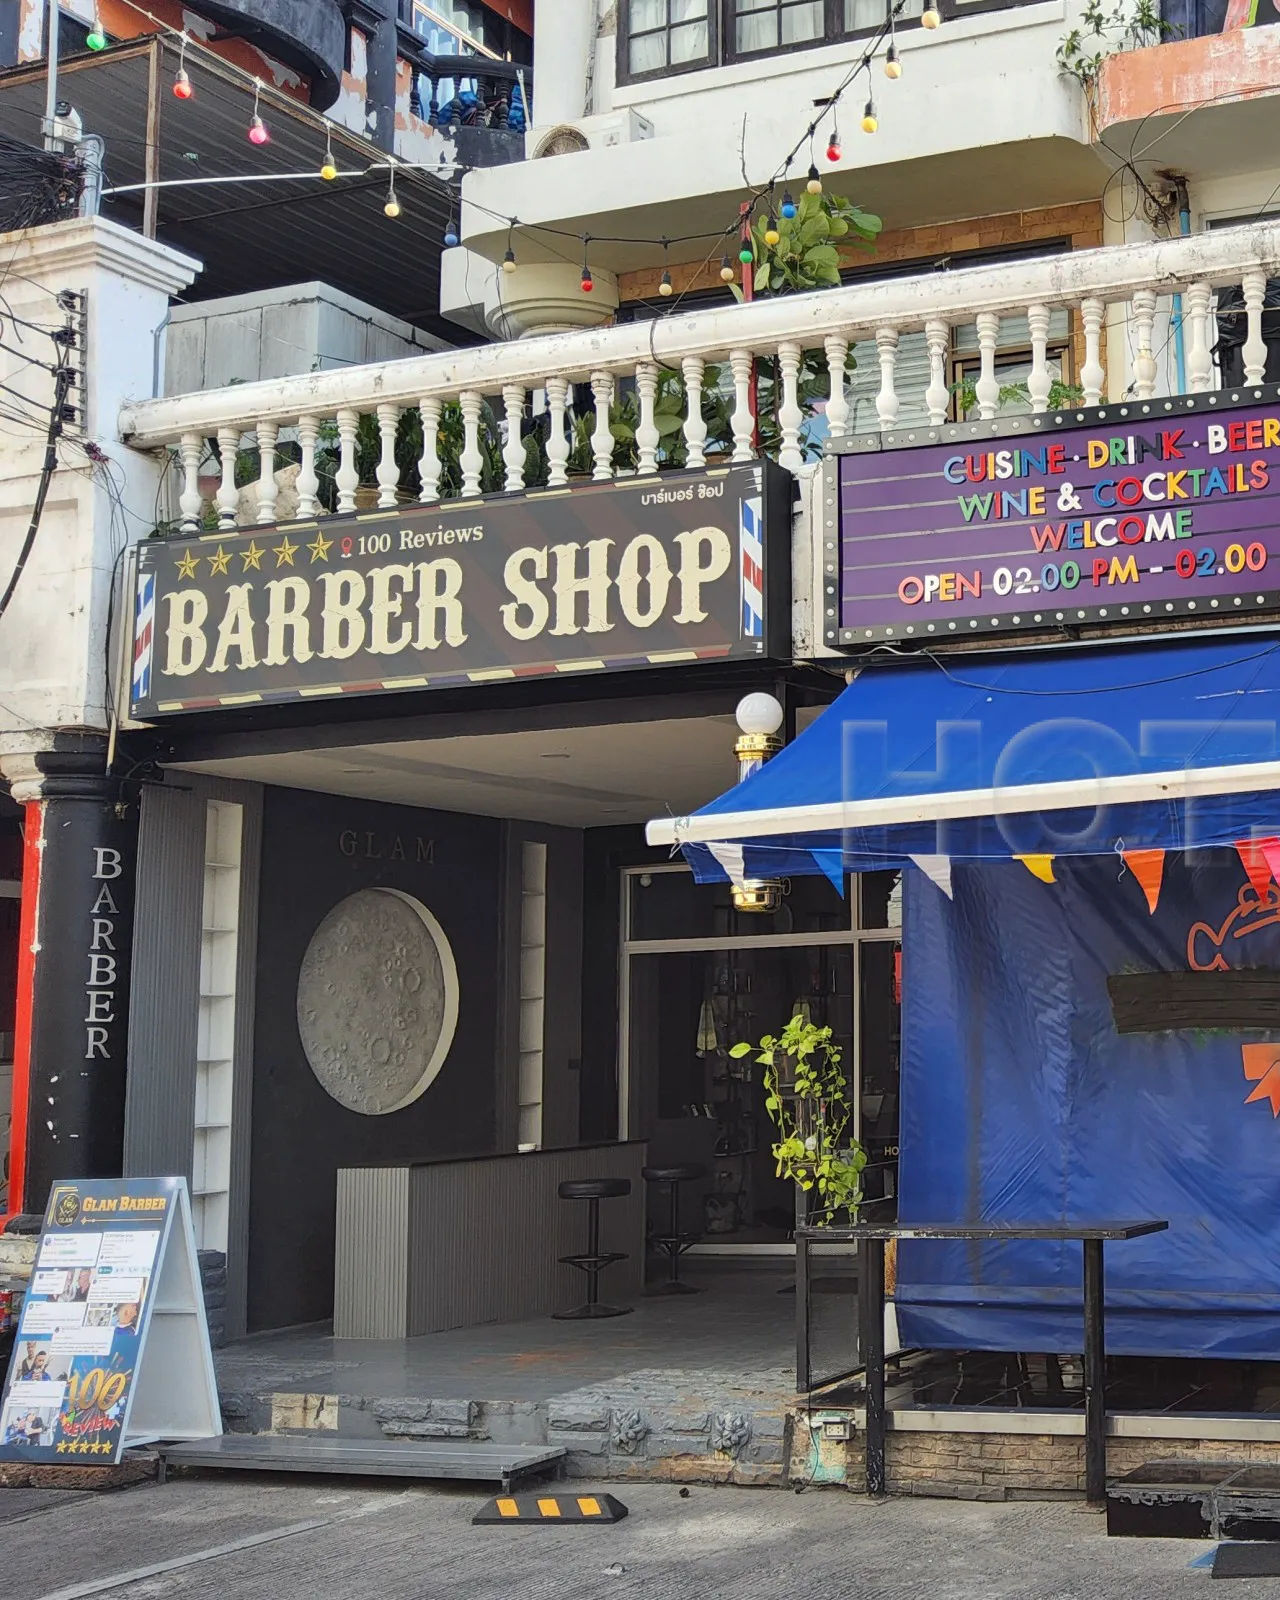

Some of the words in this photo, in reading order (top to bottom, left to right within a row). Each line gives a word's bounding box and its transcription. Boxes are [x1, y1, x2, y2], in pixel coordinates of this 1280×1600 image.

[943, 443, 1065, 484] CUISINE
[1088, 429, 1185, 470] DRINK
[958, 486, 1046, 522] WINE
[1057, 482, 1082, 512] &
[1092, 460, 1270, 508] COCKTAILS
[357, 533, 391, 556] 100
[399, 524, 484, 551] Reviews
[1030, 509, 1193, 553] WELCOME
[898, 570, 982, 605] OPEN
[992, 560, 1080, 597] 02.00
[1091, 555, 1139, 587] PM
[1174, 541, 1267, 579] 02.00
[160, 556, 469, 676] BARBER
[499, 525, 732, 642] SHOP
[339, 829, 435, 865] GLAM
[84, 847, 123, 1060] BARBER
[82, 1196, 118, 1212] GLAM
[118, 1195, 167, 1212] BARBER
[67, 1367, 126, 1414] 100
[62, 1415, 117, 1437] REVIEW
